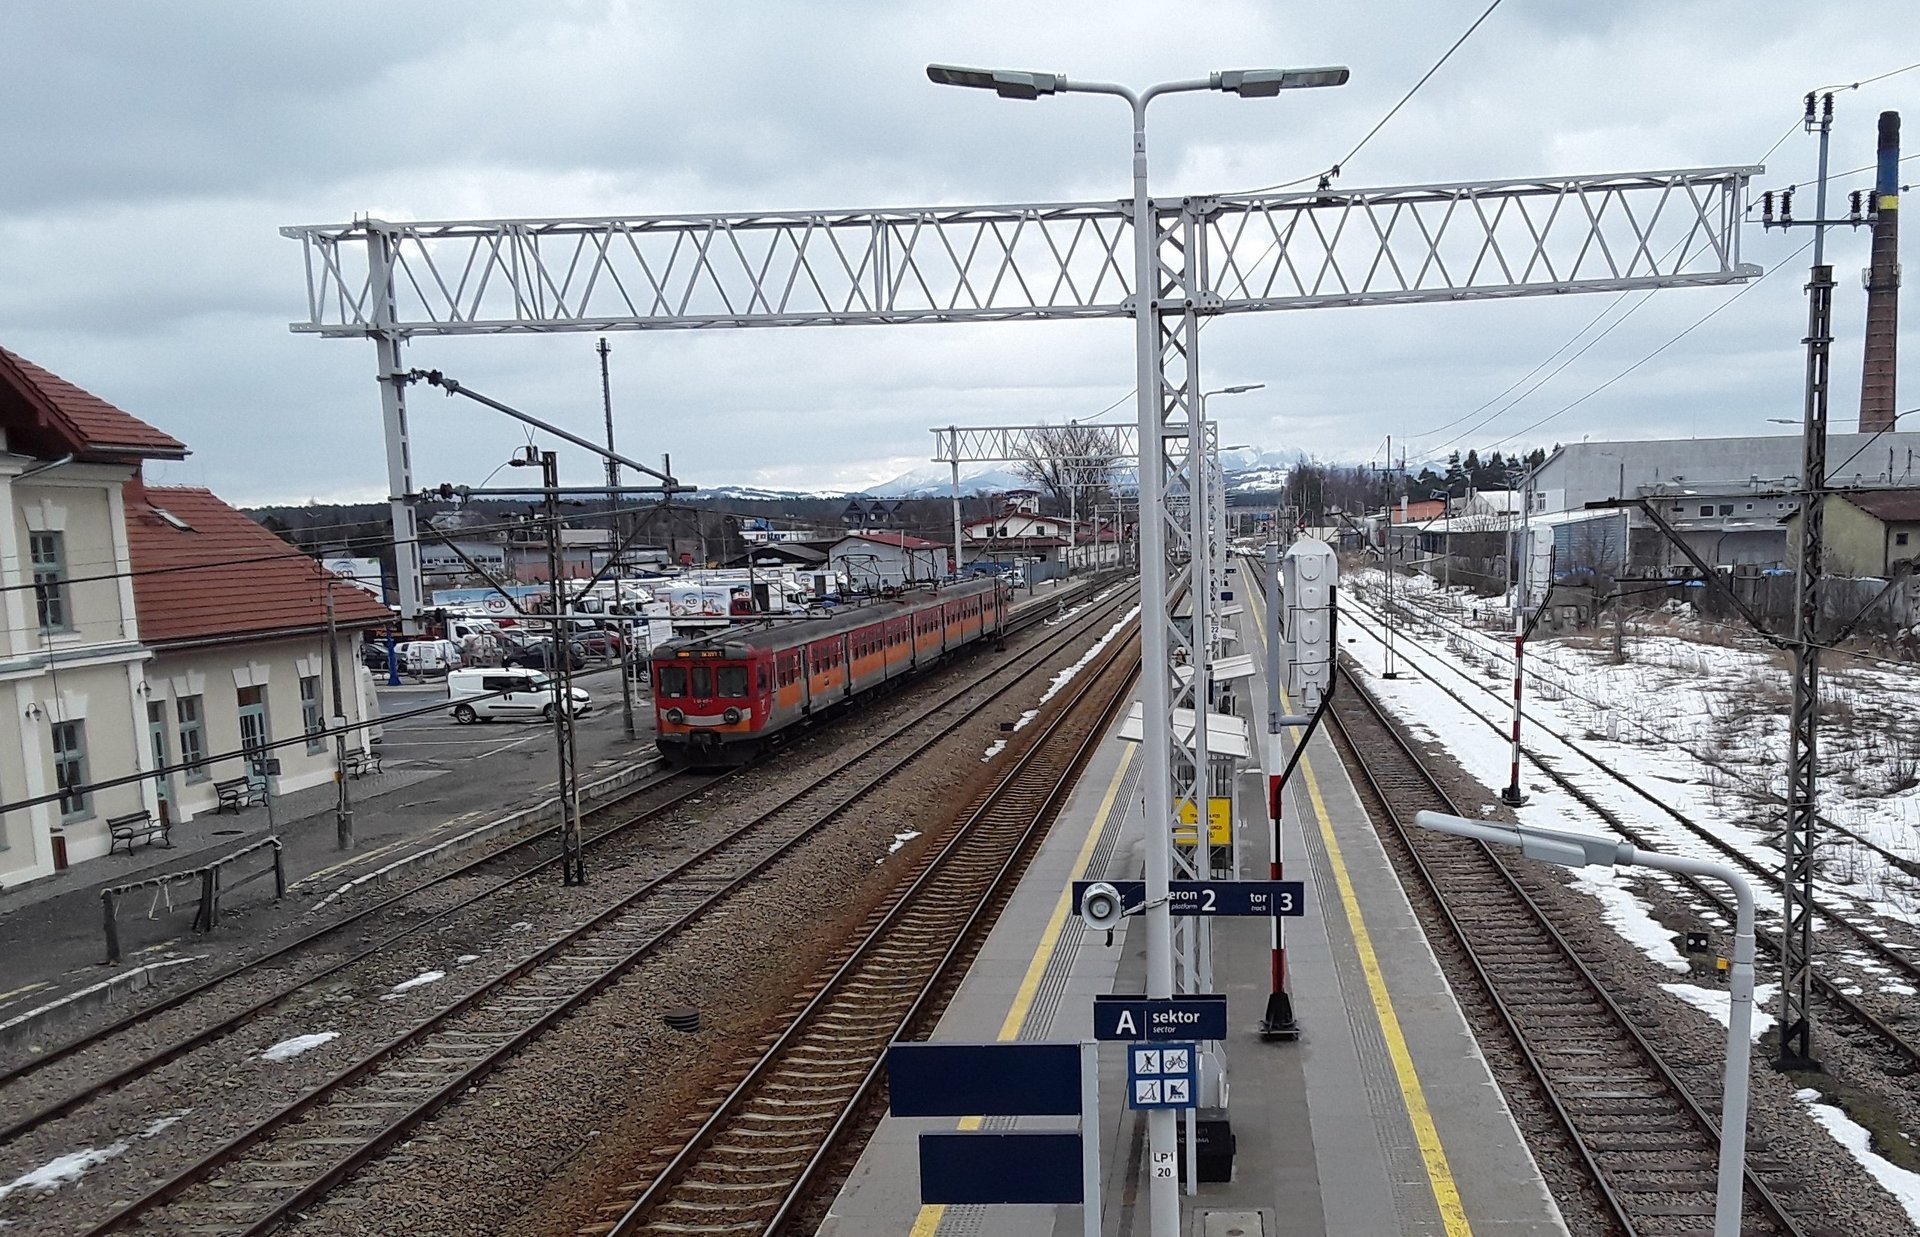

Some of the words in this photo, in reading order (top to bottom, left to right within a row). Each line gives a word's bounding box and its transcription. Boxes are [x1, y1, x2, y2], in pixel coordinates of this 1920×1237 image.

[1169, 890, 1198, 900] eron
[1201, 889, 1216, 911] 2
[1250, 892, 1268, 903] tor
[1280, 892, 1293, 911] 3
[1171, 903, 1198, 912] platform
[1115, 1009, 1137, 1035] A
[1152, 1009, 1200, 1023] sektor
[1152, 1025, 1177, 1034] sector
[1153, 1151, 1174, 1164] LP1
[1157, 1167, 1171, 1178] 20
